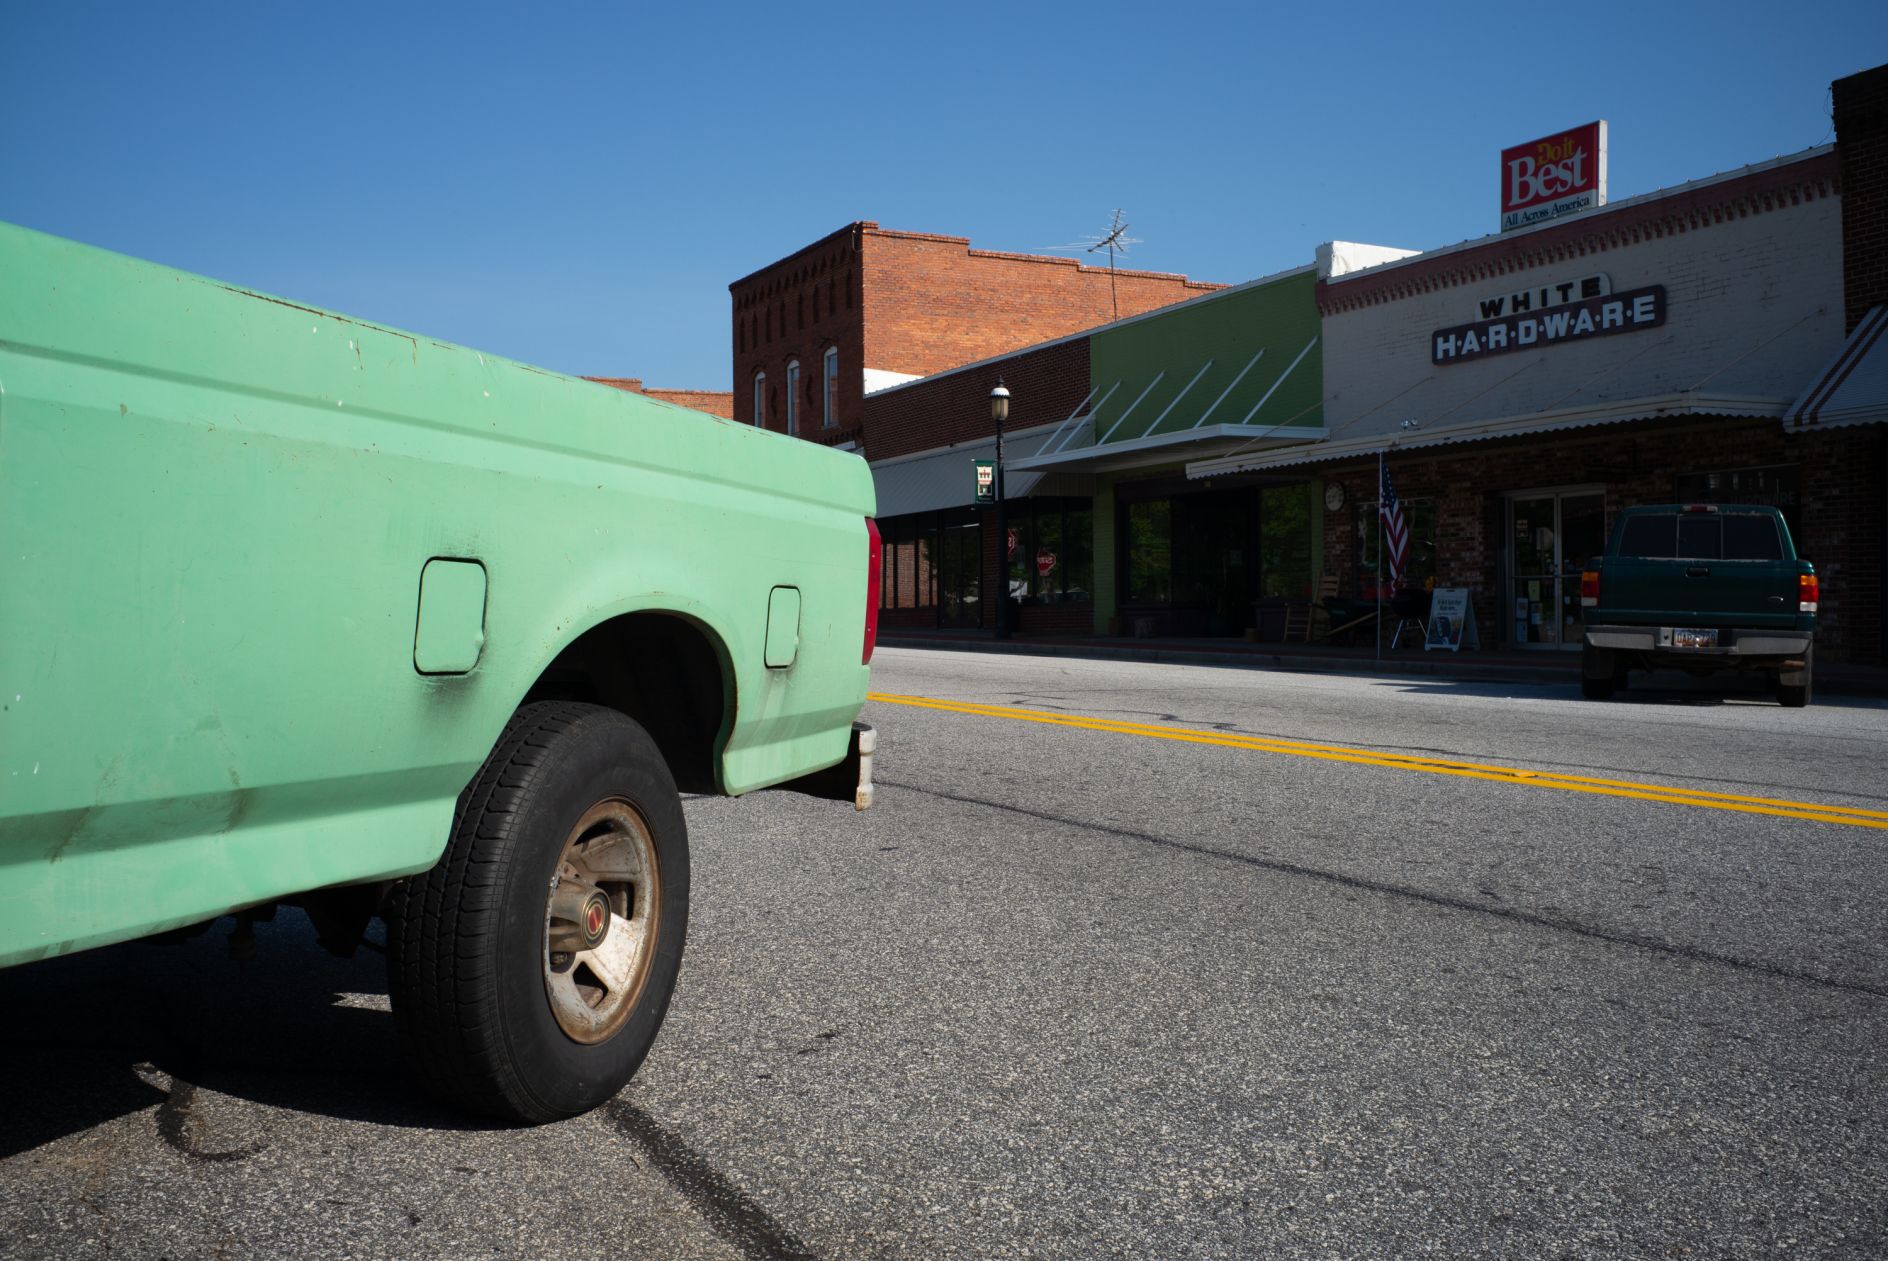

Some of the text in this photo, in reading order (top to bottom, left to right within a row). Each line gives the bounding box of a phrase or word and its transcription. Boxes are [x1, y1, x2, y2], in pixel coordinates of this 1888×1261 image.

[1538, 137, 1574, 166] Do it
[1508, 145, 1588, 206] Best
[1505, 196, 1590, 227] All Across America
[1480, 276, 1601, 319] WHITE
